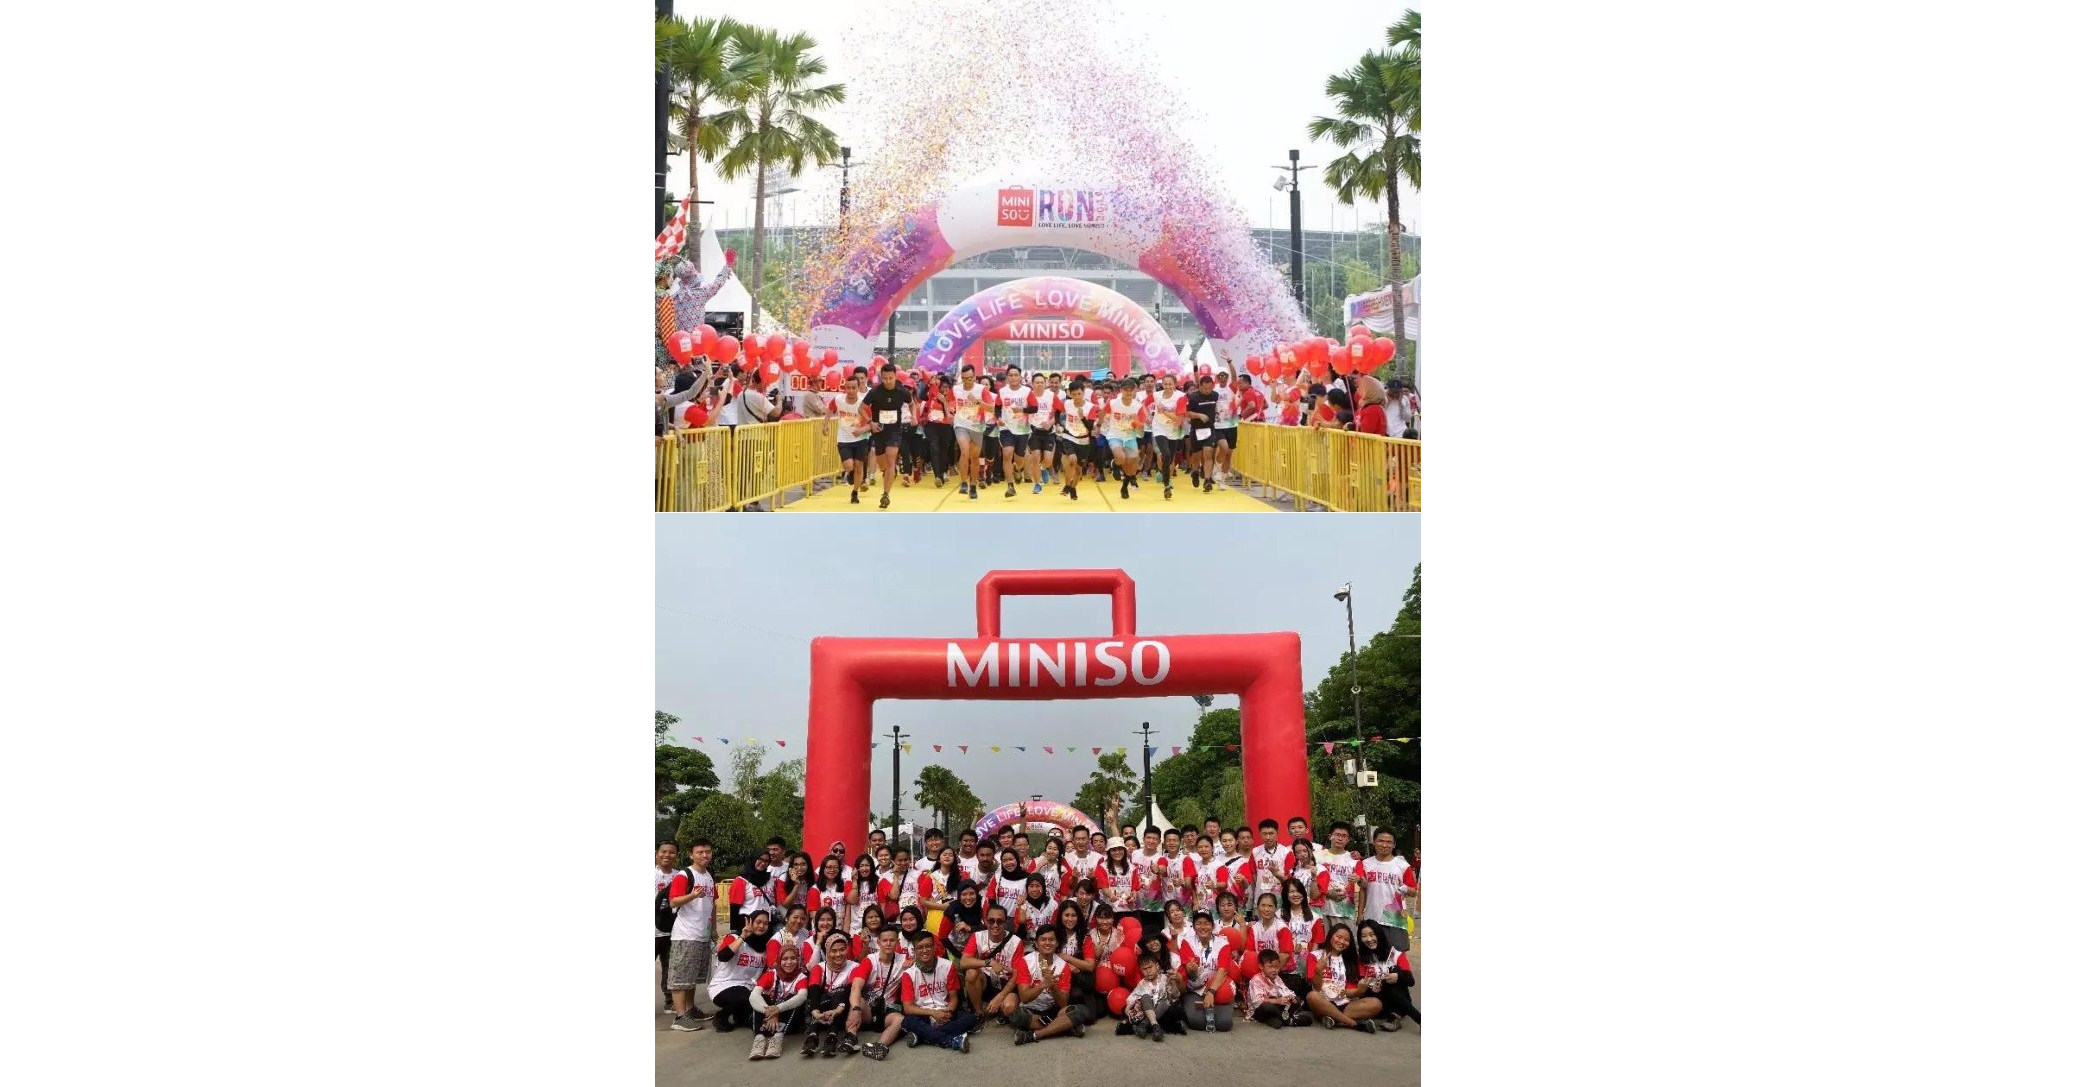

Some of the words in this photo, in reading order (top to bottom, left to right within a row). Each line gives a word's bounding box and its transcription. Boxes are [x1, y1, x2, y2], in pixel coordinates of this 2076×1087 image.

[1002, 196, 1029, 207] MINI
[1040, 189, 1094, 221] RUN
[927, 314, 976, 365] LOVE
[977, 293, 1022, 321] LIFE
[1035, 290, 1090, 310] LOVE
[1096, 302, 1160, 358] MINISO
[1009, 322, 1085, 339] MINISO
[946, 641, 1170, 687] MINISO
[976, 818, 995, 839] OVE
[996, 809, 1021, 822] LIFE
[1028, 806, 1060, 816] LOVE
